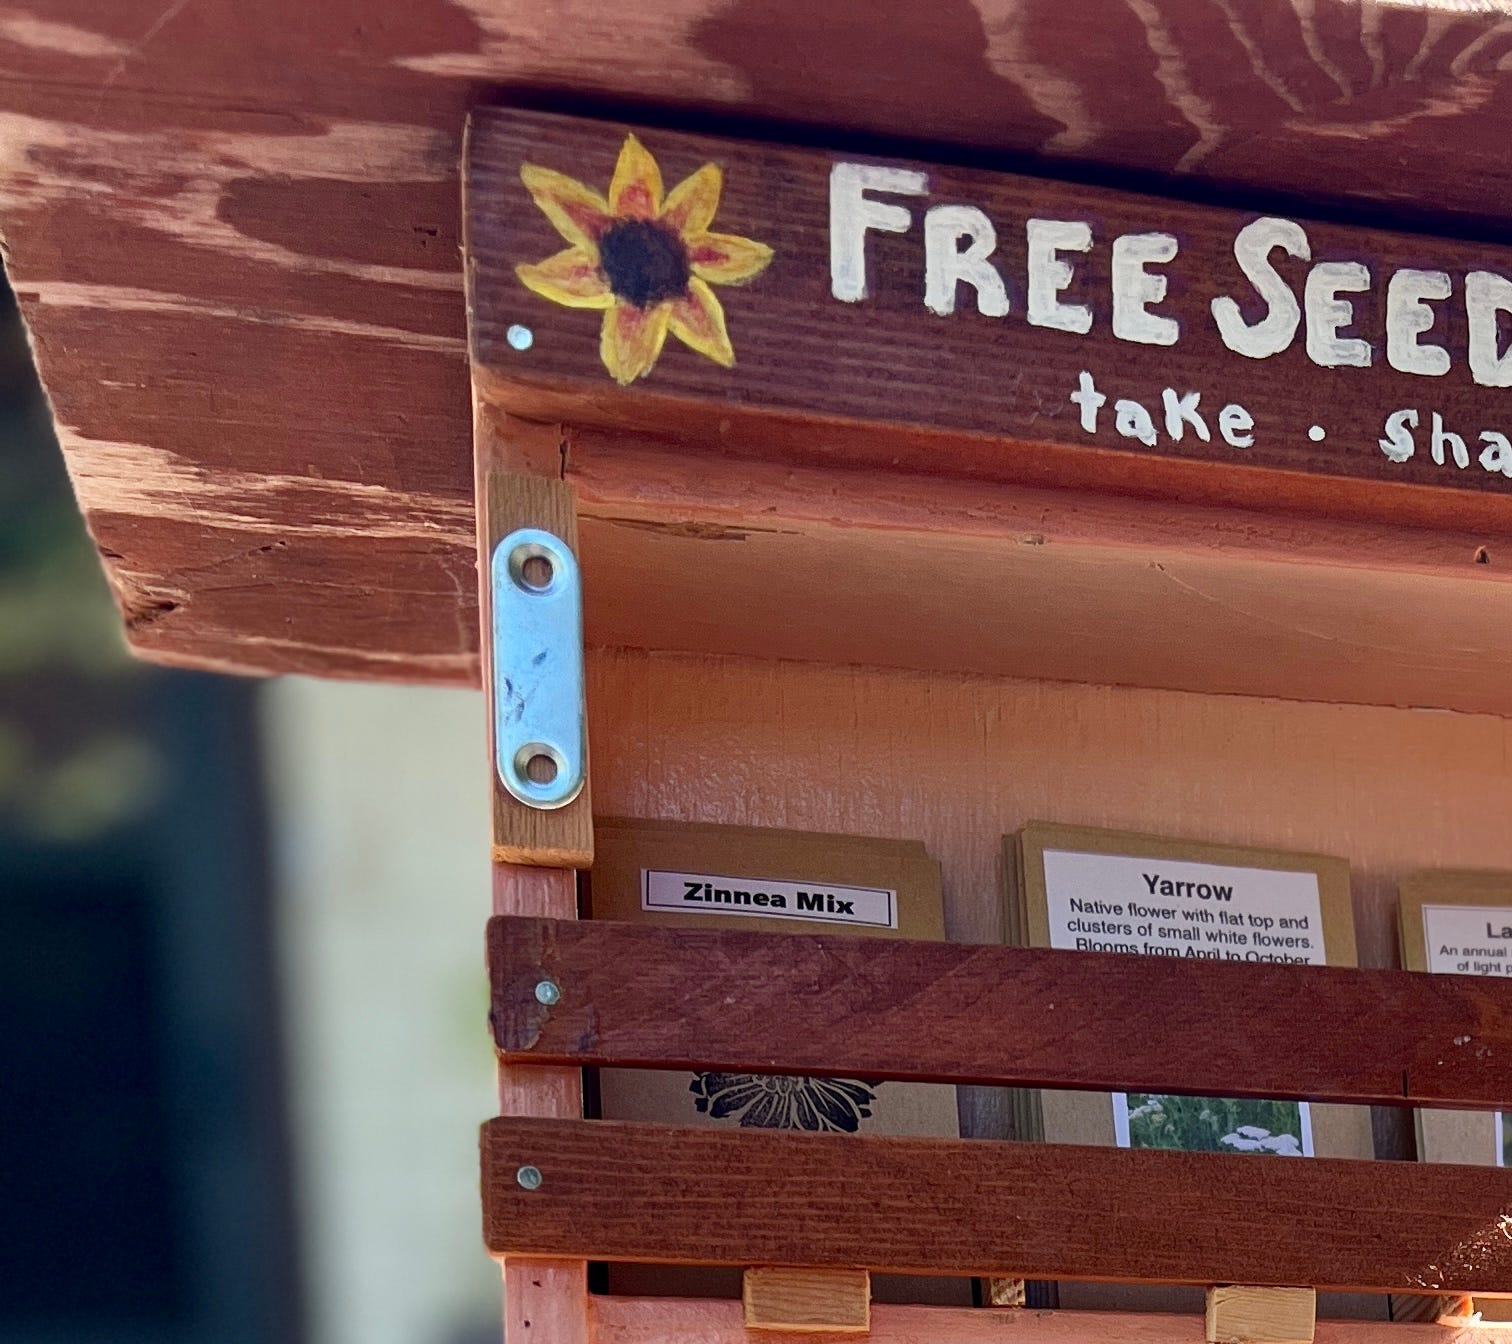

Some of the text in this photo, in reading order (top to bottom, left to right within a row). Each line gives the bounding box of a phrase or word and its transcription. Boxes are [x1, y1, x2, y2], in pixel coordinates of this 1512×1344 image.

[829, 162, 1179, 346] FREE
[1071, 370, 1255, 448] take
[683, 881, 855, 915] Zinnea Mix
[1143, 873, 1233, 901] Yarrow
[1069, 898, 1310, 931] Native flower with flat top and
[1067, 918, 1315, 949] clusters of small white flowers.
[1144, 941, 1181, 958] from
[1439, 945, 1458, 957] An
[1463, 946, 1508, 958] annual
[1457, 961, 1470, 972] of
[1474, 961, 1502, 975] light
